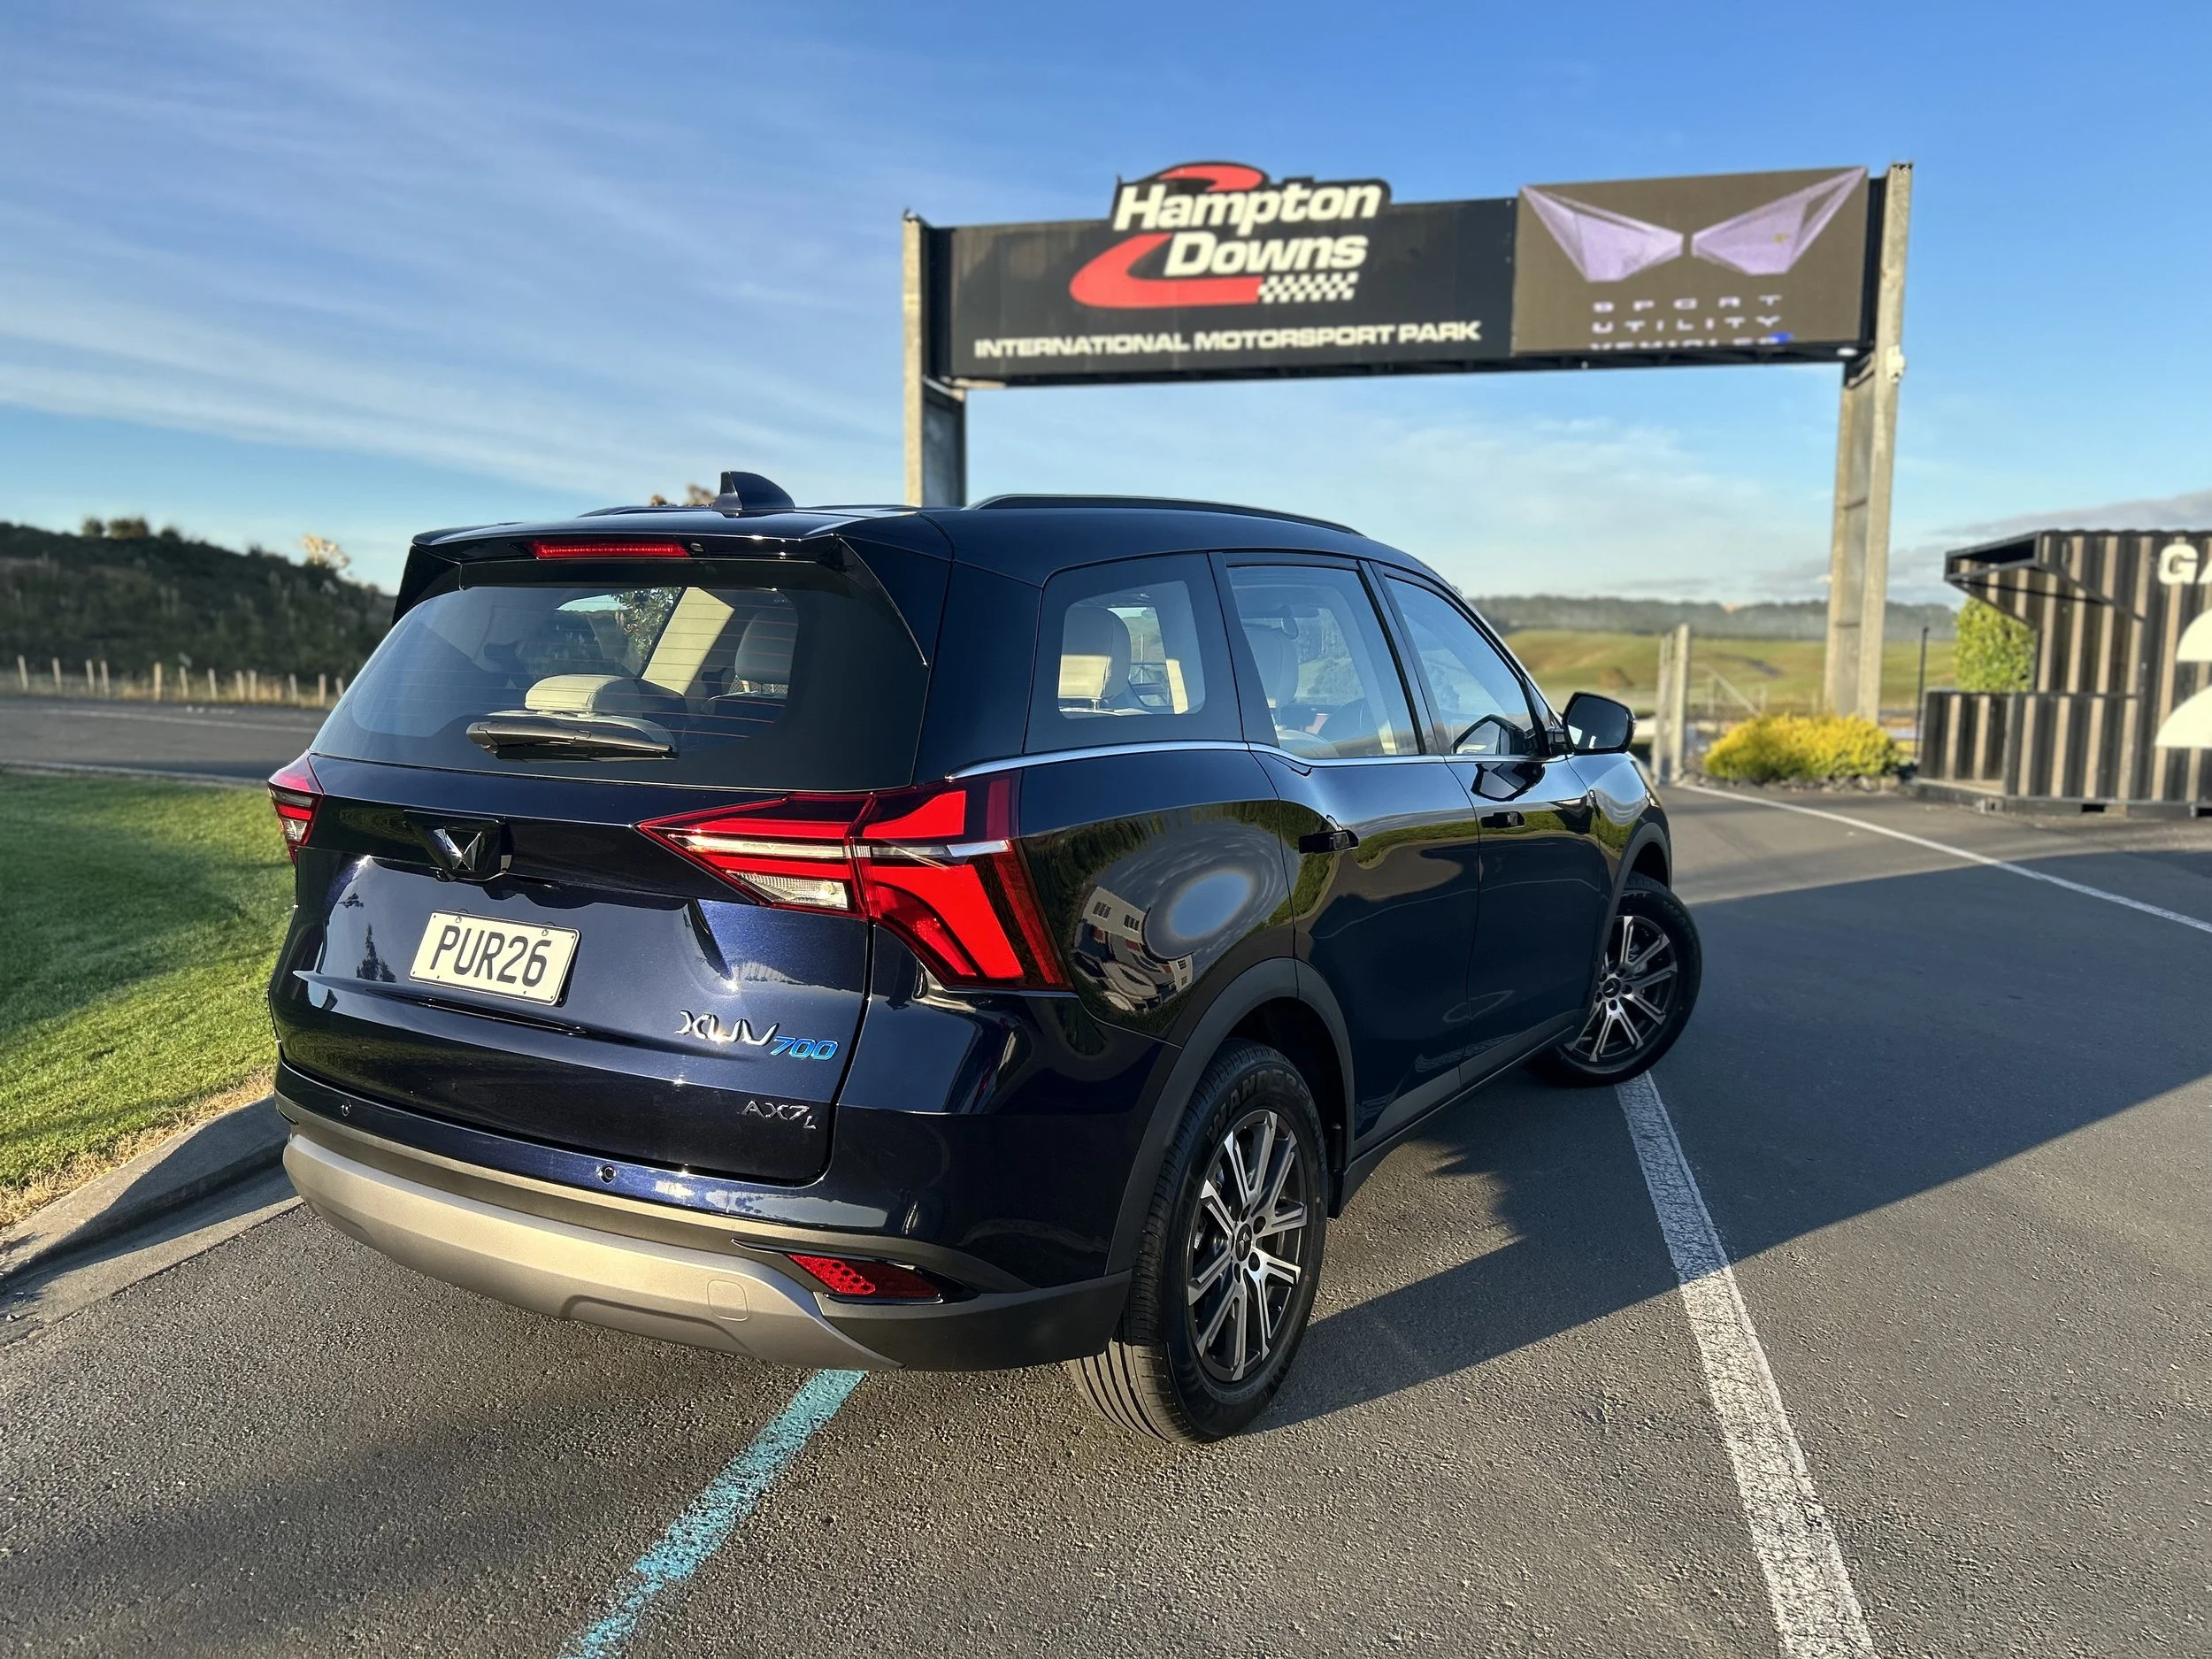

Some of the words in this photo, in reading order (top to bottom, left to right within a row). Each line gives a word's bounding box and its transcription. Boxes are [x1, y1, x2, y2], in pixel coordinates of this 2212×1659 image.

[1113, 183, 1381, 235] Hampton
[1164, 231, 1368, 276] Downs
[974, 332, 1191, 358] INTERNATIONAL
[1194, 324, 1393, 350] MOTORSPORT
[1398, 320, 1483, 342] PARK
[1592, 315, 1781, 334] UTILITY
[429, 925, 551, 987] PUR26
